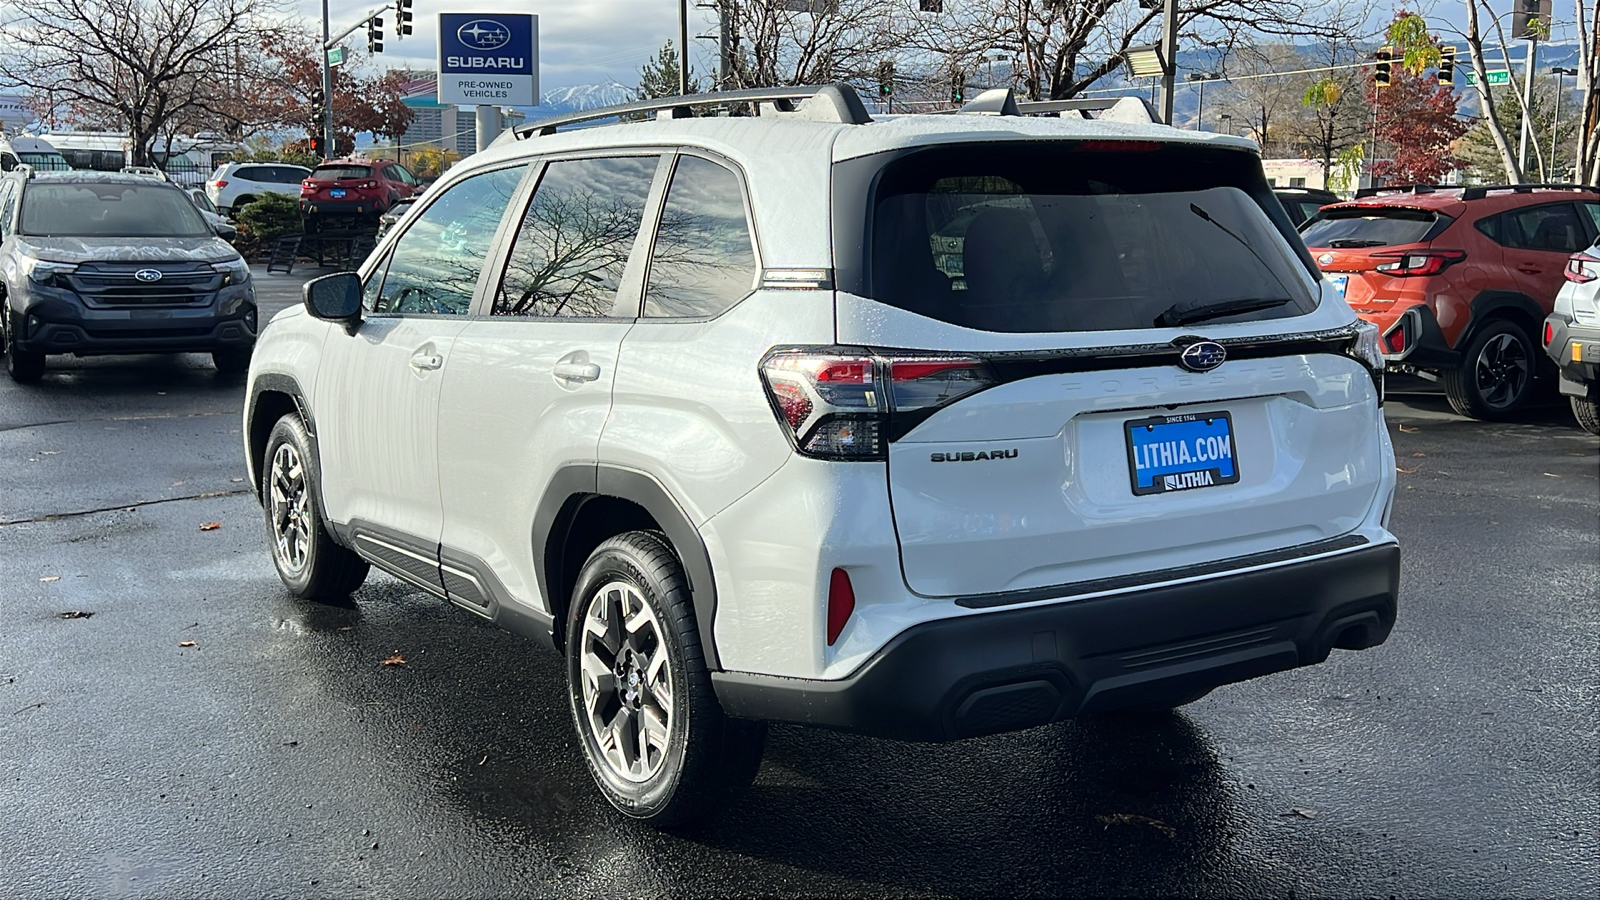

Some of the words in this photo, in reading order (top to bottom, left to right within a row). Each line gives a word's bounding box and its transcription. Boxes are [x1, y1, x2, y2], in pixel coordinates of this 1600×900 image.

[447, 56, 524, 69] SUBARU
[458, 81, 513, 89] PRE-OWNED
[463, 90, 508, 98] VEHICLES
[1060, 363, 1312, 392] FORESTER
[1166, 415, 1183, 424] SINCE
[930, 448, 1018, 462] SUBARU
[1133, 434, 1232, 470] LITHIA.COM
[1175, 470, 1214, 489] LITHIA
